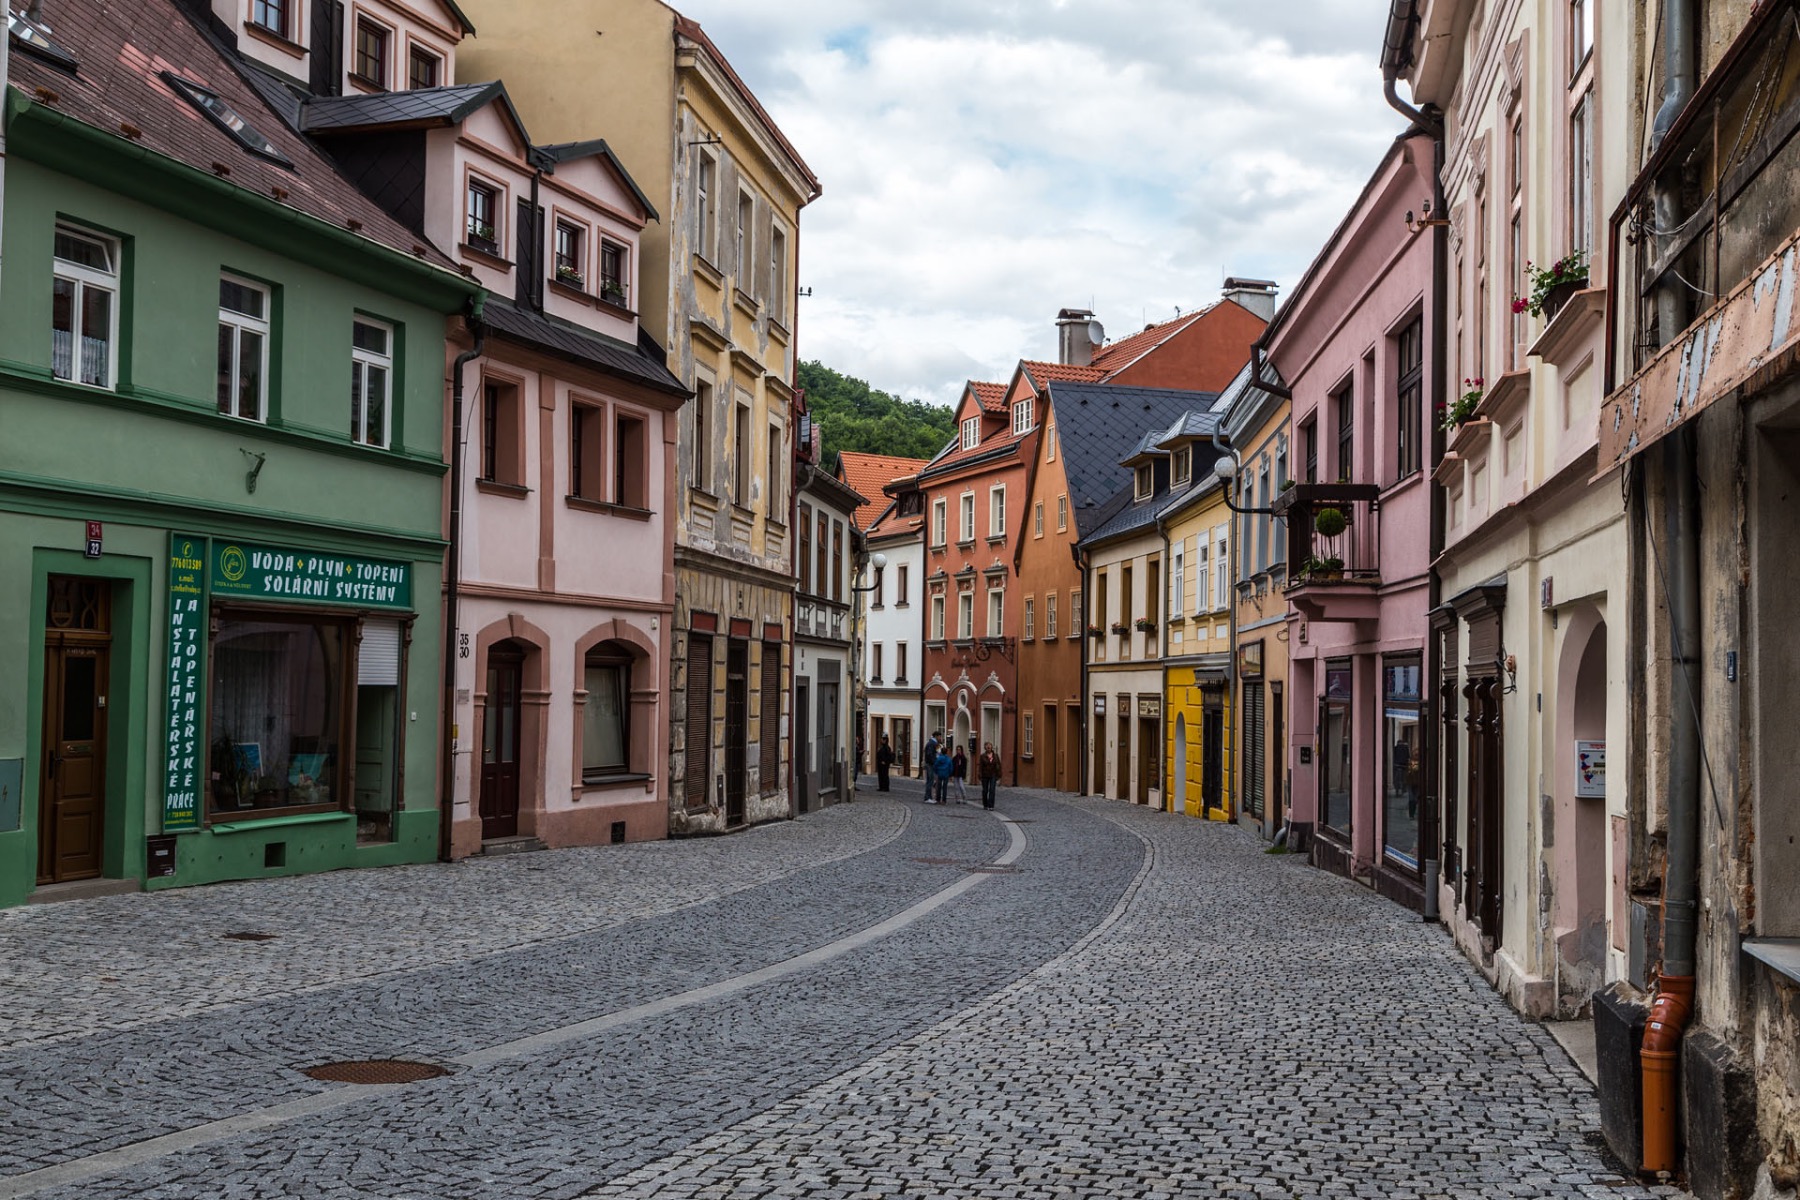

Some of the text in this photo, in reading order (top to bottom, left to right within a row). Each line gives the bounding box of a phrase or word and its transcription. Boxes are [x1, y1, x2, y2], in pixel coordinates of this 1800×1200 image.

[91, 524, 100, 536] 34
[91, 543, 100, 554] 32
[252, 552, 294, 572] VODA
[307, 557, 344, 577] PLYN
[356, 565, 404, 583] TOPENÍ
[264, 575, 329, 597] SOLÁRNÍ
[335, 581, 396, 602] SYSTÉMY
[460, 634, 469, 645] 35
[460, 647, 469, 658] 30
[169, 599, 184, 787] INSTALATÉRSKÉ
[183, 599, 198, 787] A TOPENÁŘSKÉ
[167, 790, 194, 809] PRÁCE
